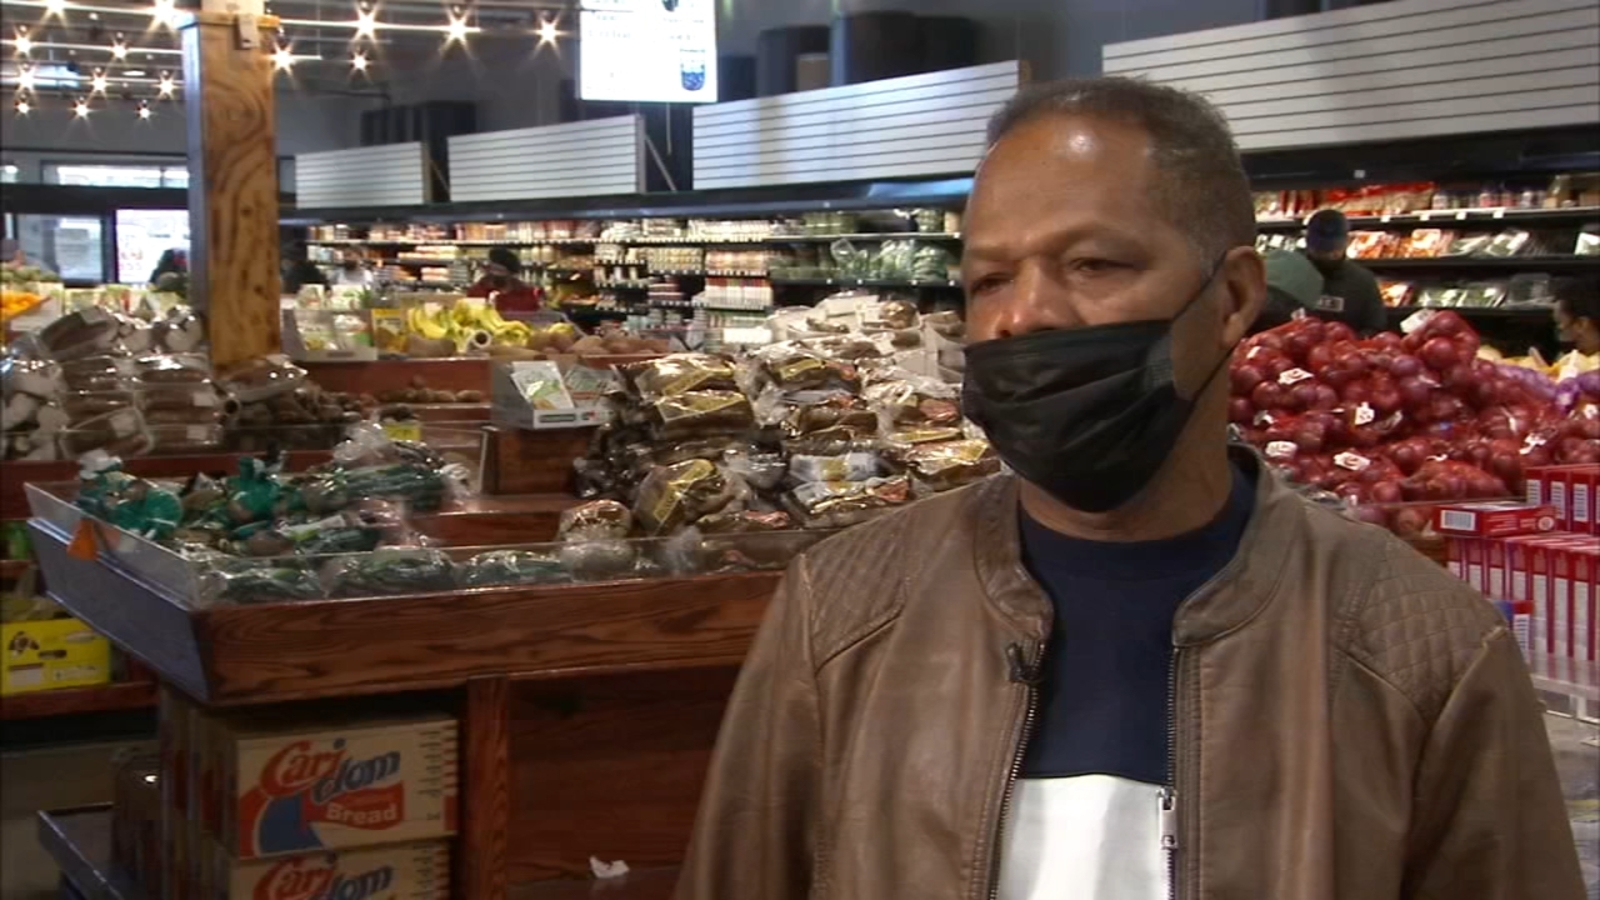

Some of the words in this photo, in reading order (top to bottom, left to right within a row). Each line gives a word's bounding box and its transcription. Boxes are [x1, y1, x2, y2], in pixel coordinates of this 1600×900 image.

[260, 738, 346, 796] Cari
[313, 751, 400, 803] dom
[326, 801, 398, 825] Bread
[252, 851, 339, 900] Cari
